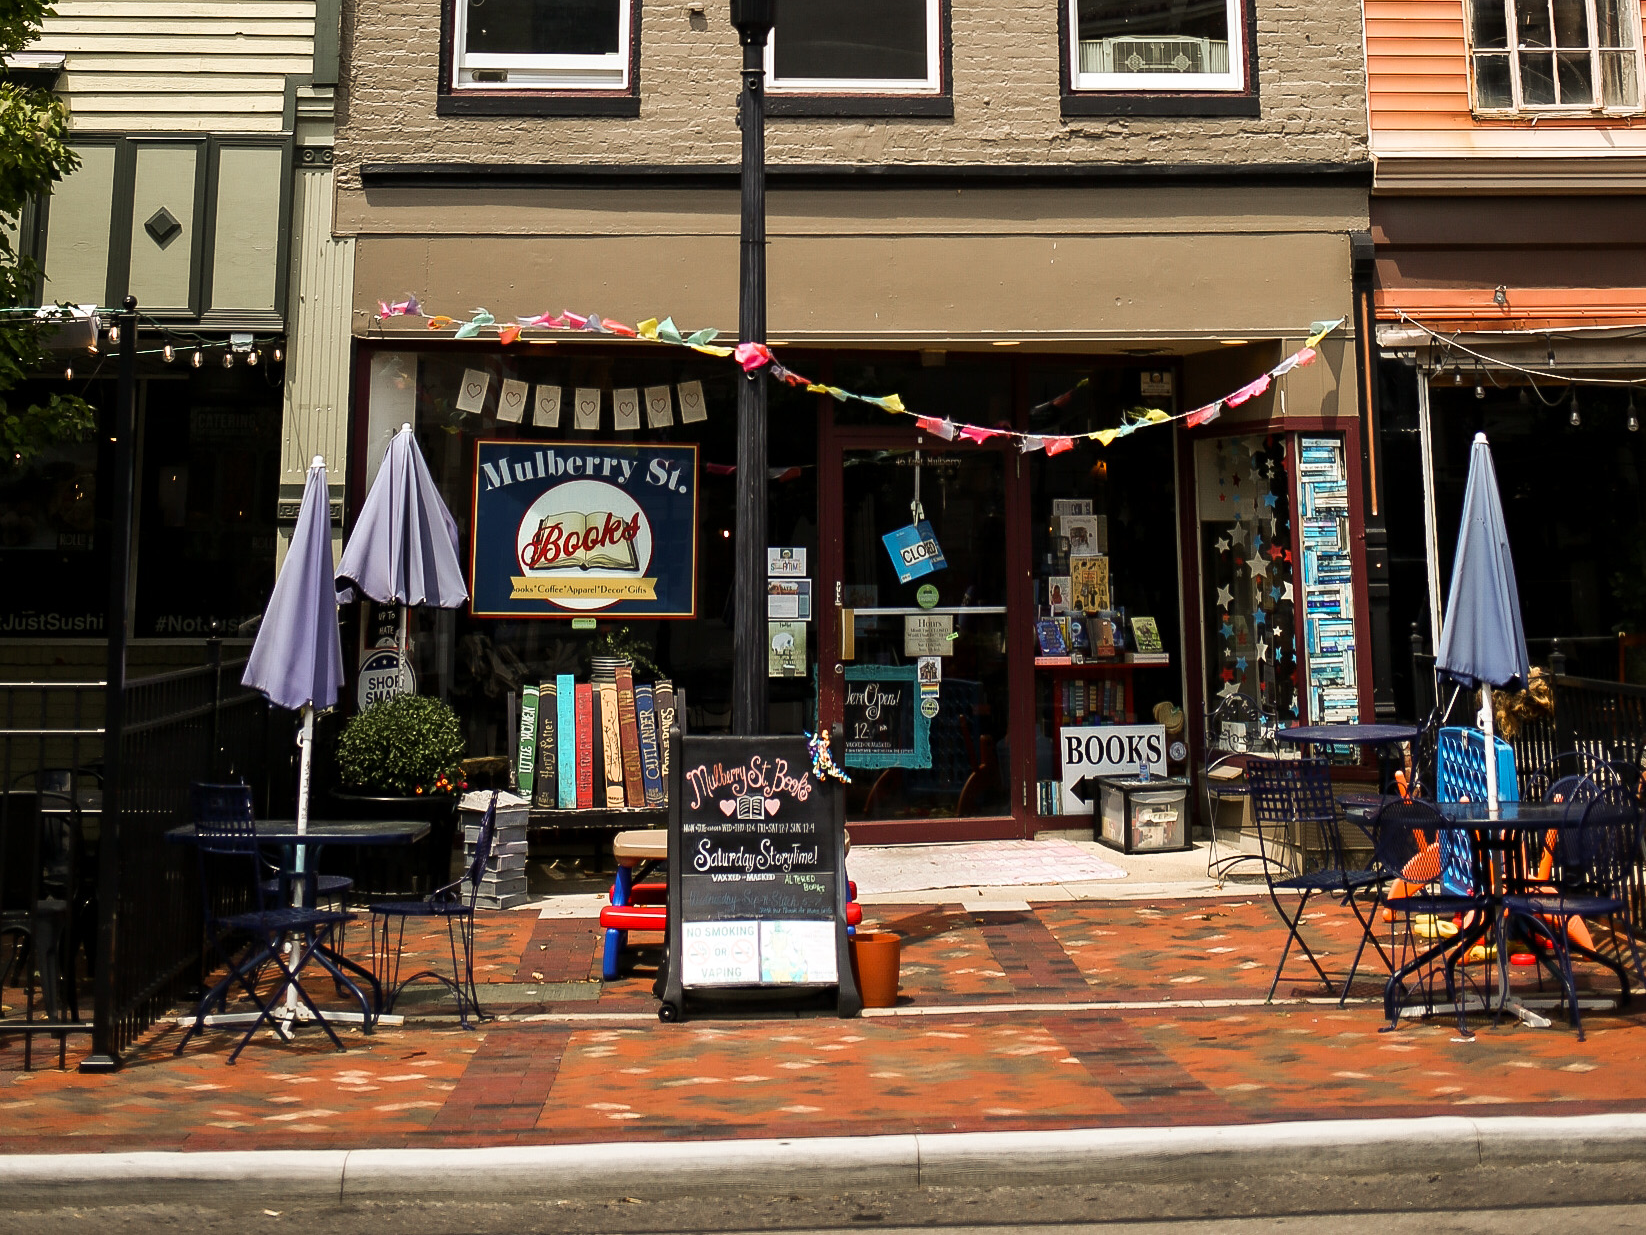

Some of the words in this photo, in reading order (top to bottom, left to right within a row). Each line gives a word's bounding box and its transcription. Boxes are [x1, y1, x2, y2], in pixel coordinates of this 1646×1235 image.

[481, 450, 637, 491] Mulberry
[646, 458, 687, 493] St.
[521, 512, 640, 567] Books
[537, 585, 563, 594] Coffee
[566, 585, 597, 595] Apparel
[600, 585, 624, 594] Decor
[627, 585, 647, 594] Gifts
[540, 718, 555, 748] Potter
[640, 708, 660, 780] OUTLANDER
[540, 750, 555, 779] Harry
[1065, 734, 1162, 766] BOOKS
[686, 763, 748, 809] Mulberry
[763, 758, 812, 802] Books
[694, 838, 756, 872] Saturday
[687, 927, 701, 938] NO
[705, 926, 755, 937] SMOKING
[714, 948, 727, 957] OR
[701, 967, 742, 978] VAPING
